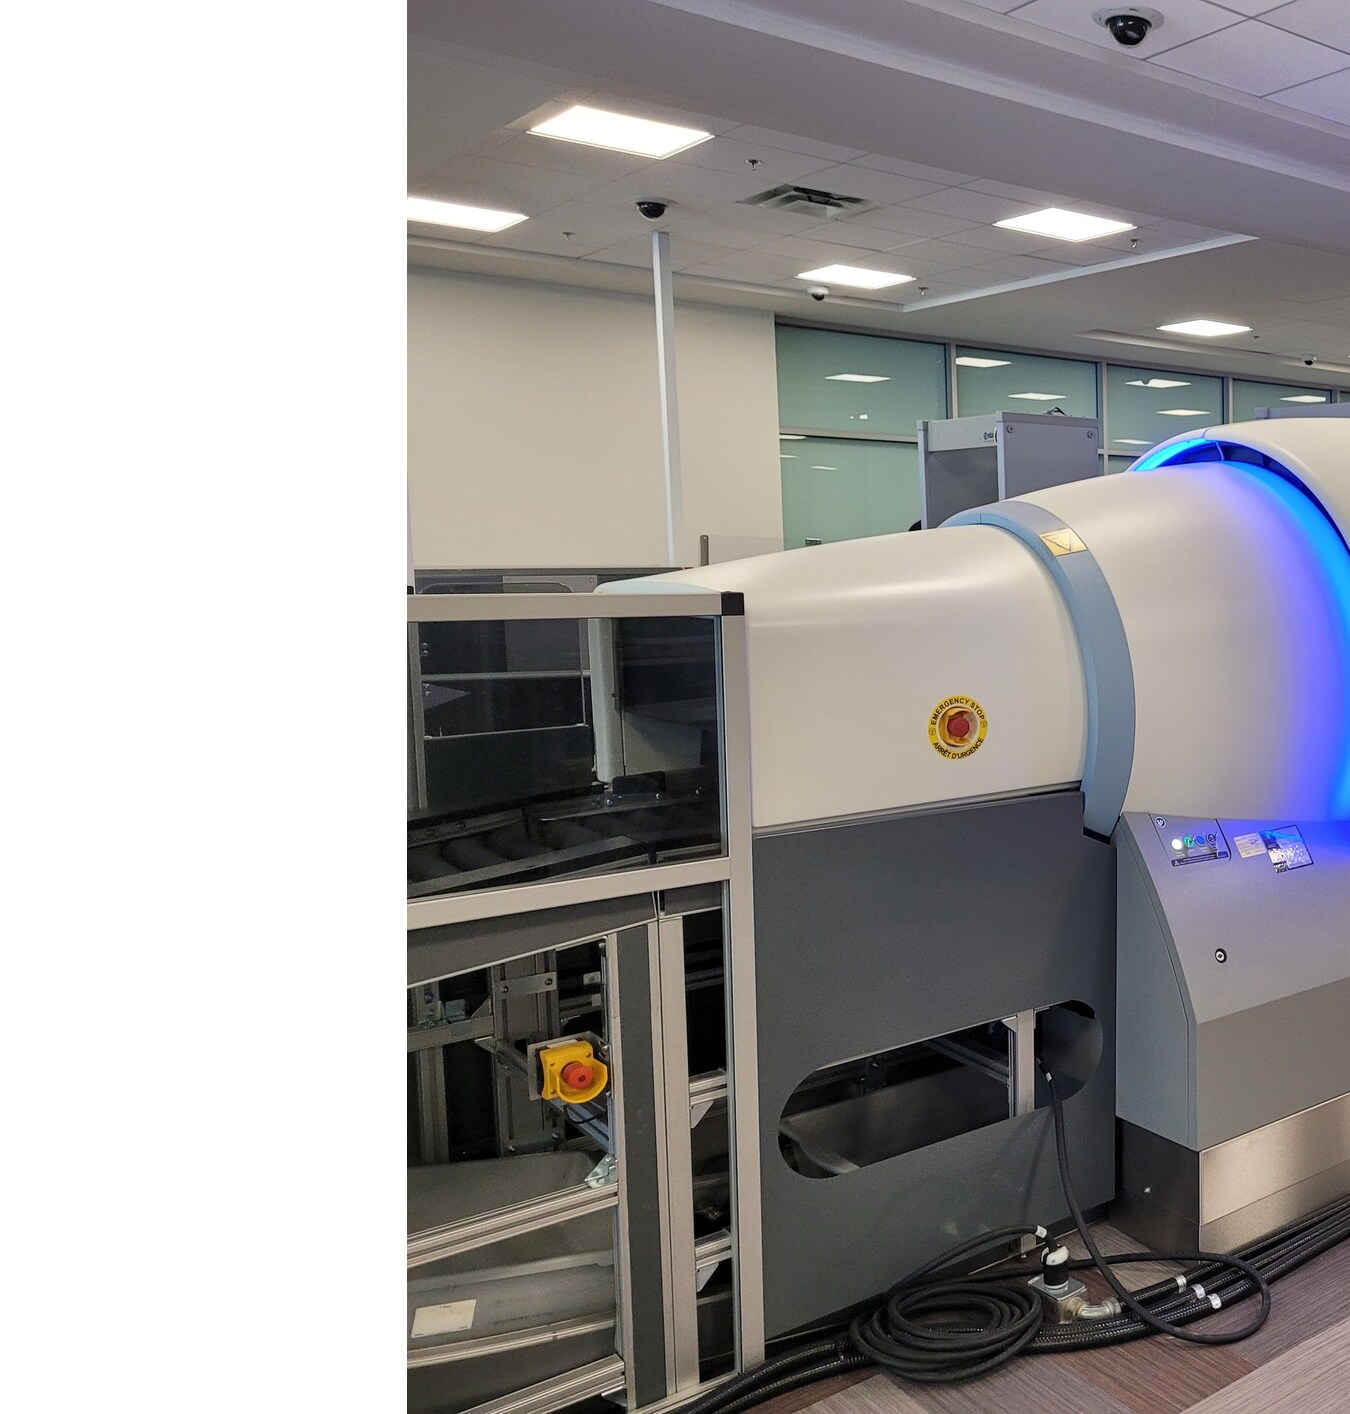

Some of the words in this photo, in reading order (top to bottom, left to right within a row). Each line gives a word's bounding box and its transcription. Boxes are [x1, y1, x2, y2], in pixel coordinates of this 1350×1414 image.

[930, 697, 970, 726] EMERGENCY
[969, 701, 985, 720] STOP
[932, 742, 952, 758] ARRÊT
[951, 736, 985, 760] D'URGENCE
